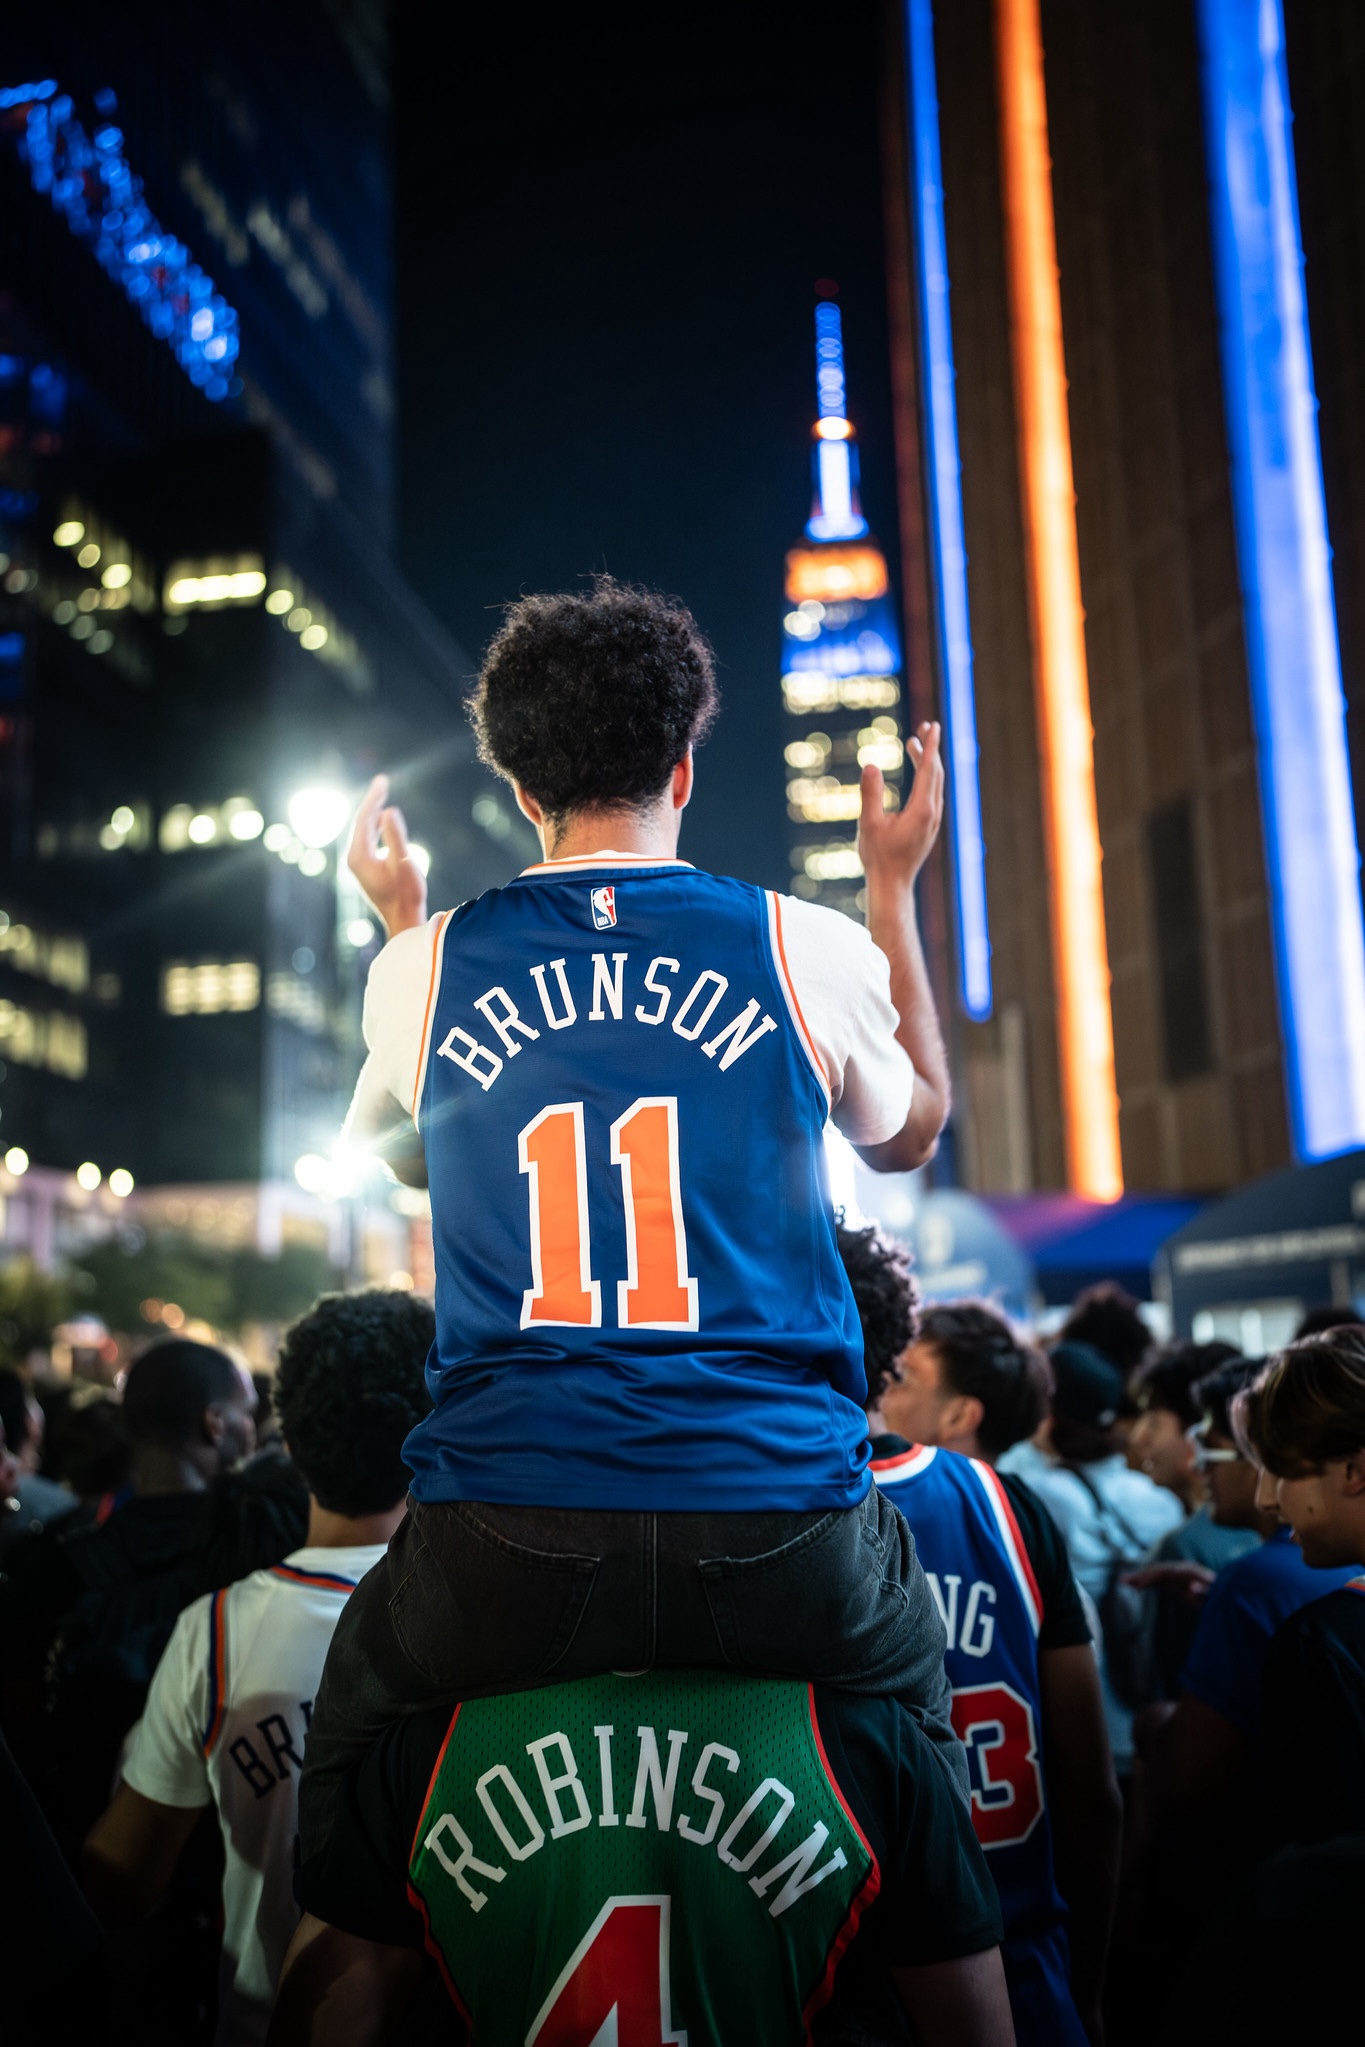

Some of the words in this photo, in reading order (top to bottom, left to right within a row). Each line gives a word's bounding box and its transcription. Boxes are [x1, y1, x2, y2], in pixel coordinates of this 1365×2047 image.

[436, 952, 778, 1092] BRUNSON
[517, 1096, 700, 1332] 11
[424, 1724, 848, 1918] ROBINSON
[524, 1894, 689, 2047] 4
